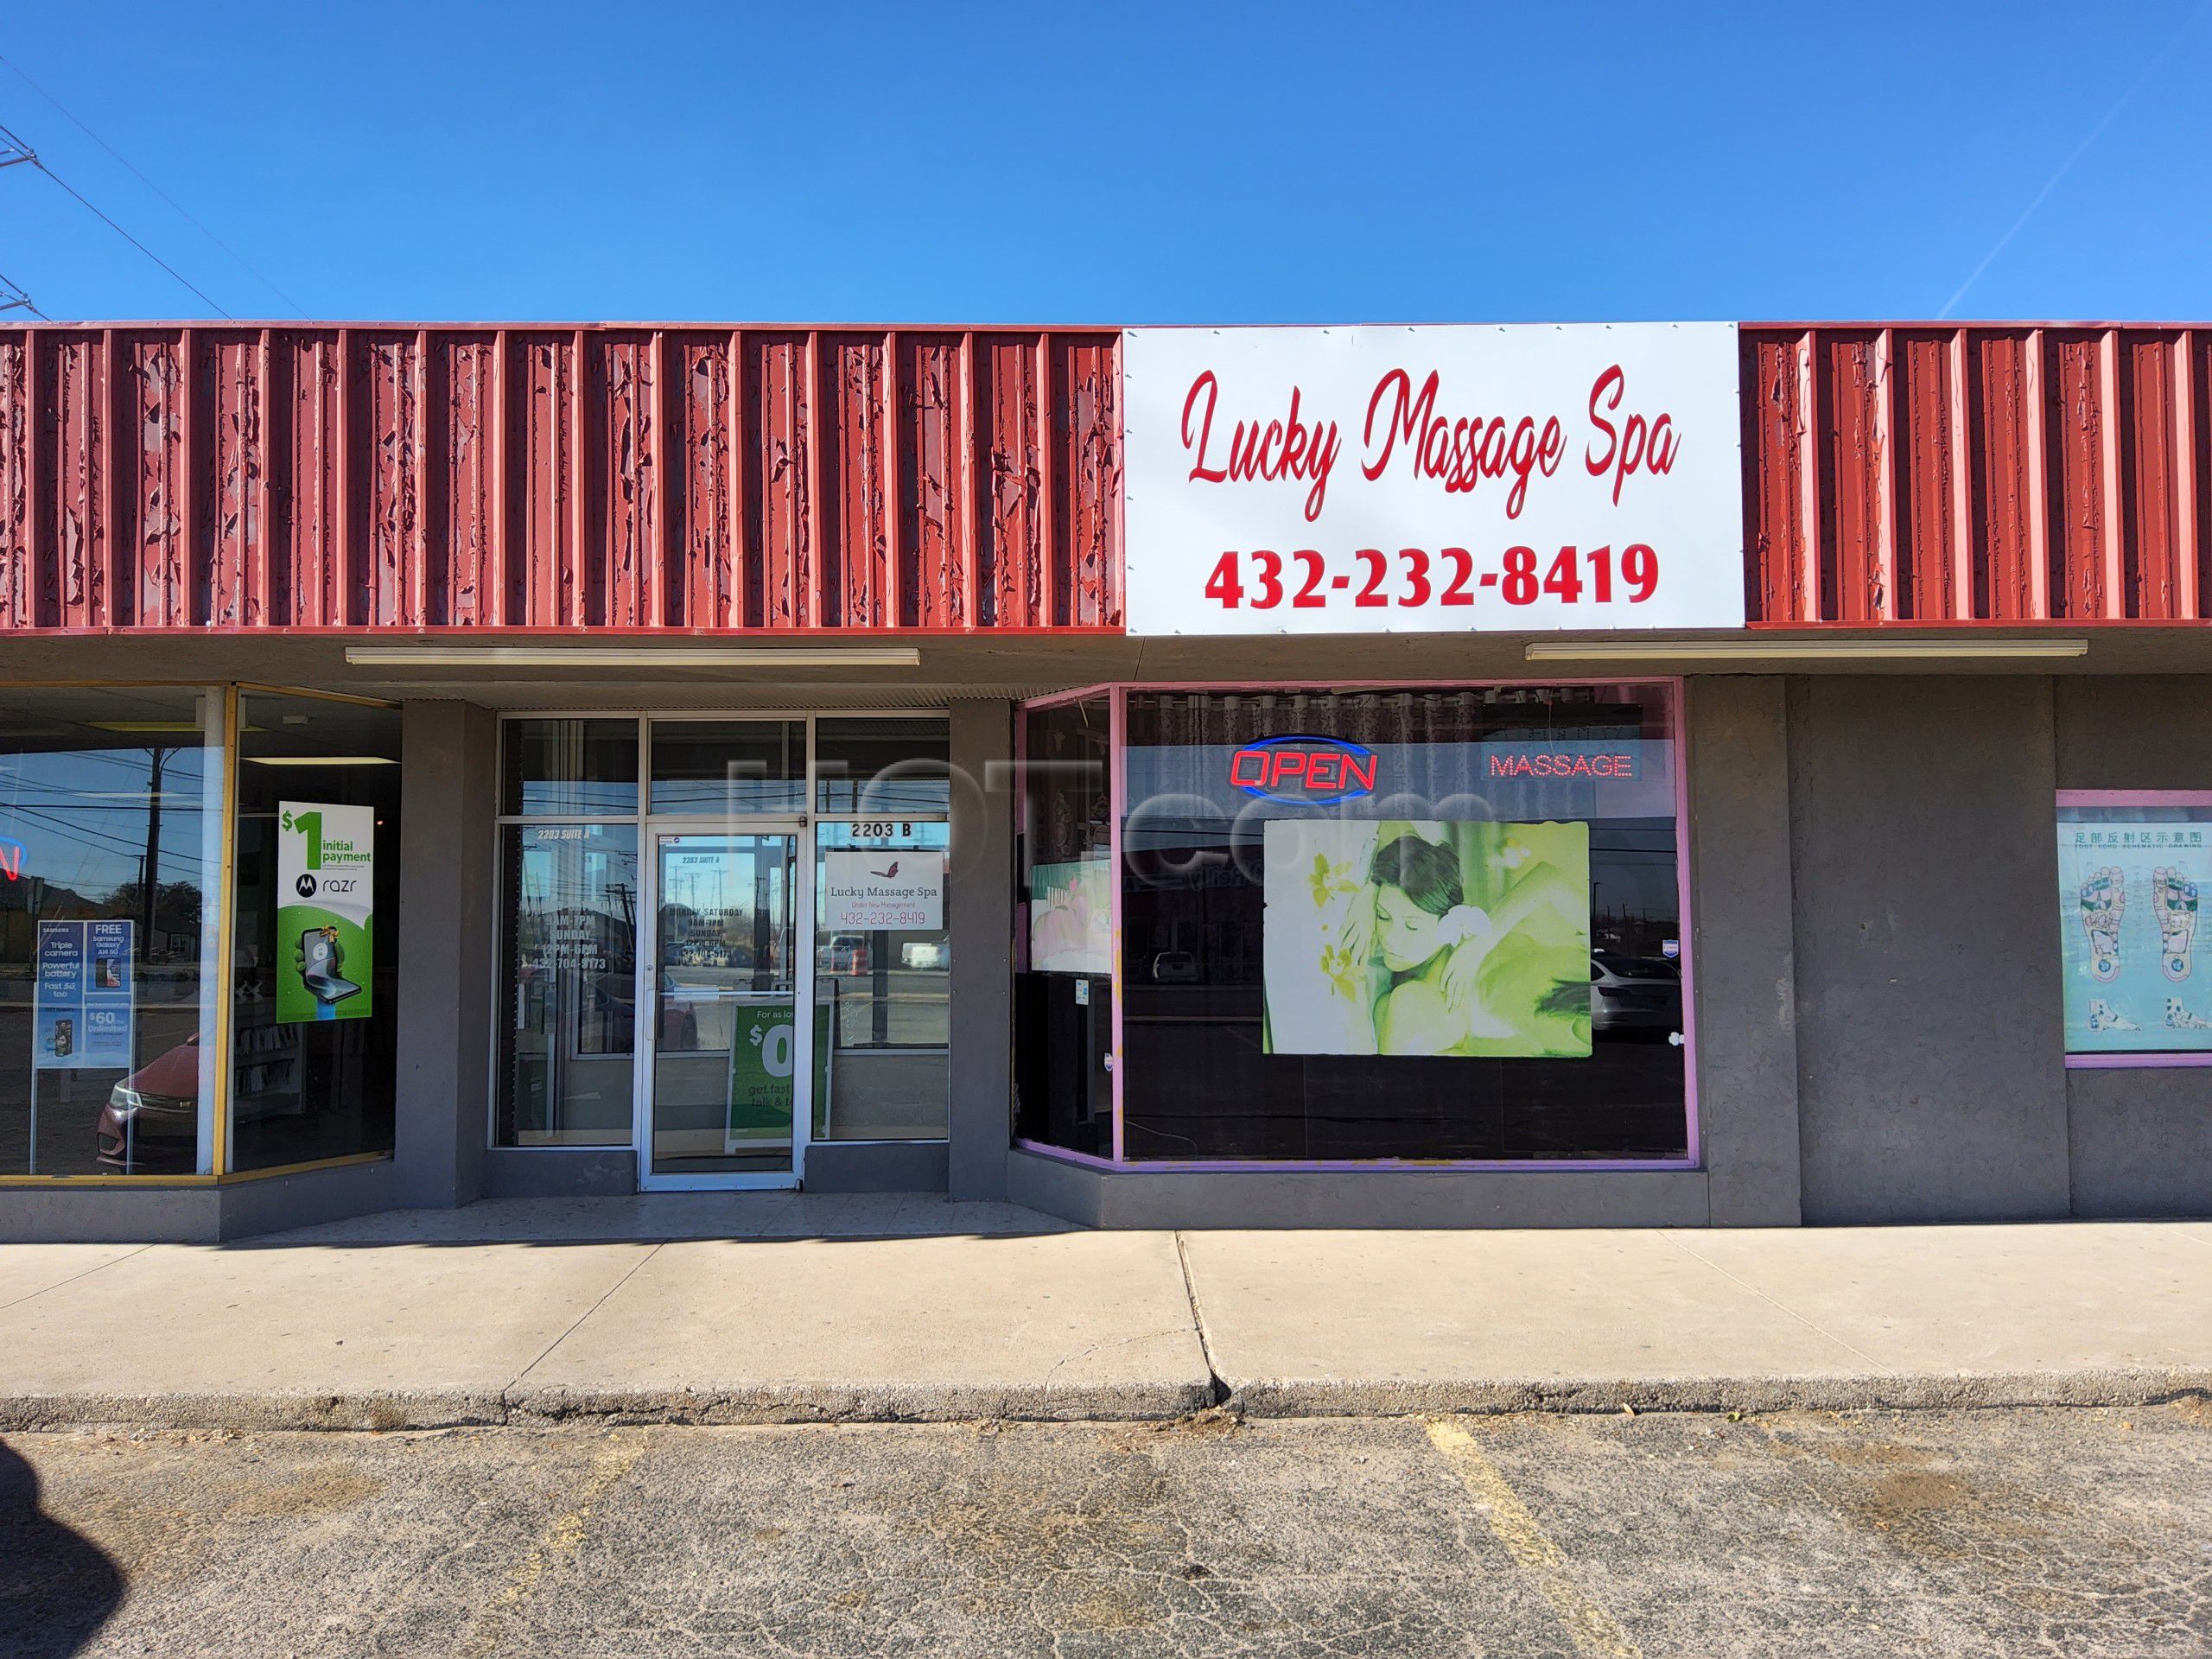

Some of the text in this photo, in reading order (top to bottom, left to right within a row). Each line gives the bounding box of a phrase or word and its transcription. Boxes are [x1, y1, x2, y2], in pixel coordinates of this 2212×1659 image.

[1180, 364, 1681, 522] Lucky Massage Spa
[1205, 543, 1659, 609] 432-232-8419
[1230, 749, 1378, 791] OPEN
[1488, 753, 1633, 778] MASSAGE
[538, 830, 560, 839] 2203
[561, 830, 582, 839] SUITE
[852, 823, 912, 837] 2203 B
[2075, 831, 2202, 843] 足部反射区示意图
[322, 840, 353, 851] initial
[322, 853, 372, 863] payment
[322, 880, 358, 893] razr
[830, 887, 938, 899] Lucky Massage Spa
[841, 912, 925, 925] 432-232-8419
[95, 924, 122, 935] FREE
[690, 929, 721, 938] SUNDAY
[45, 970, 77, 979] battery
[89, 1011, 116, 1025] $60
[757, 1010, 772, 1019] For
[783, 1010, 793, 1019] lo
[87, 1024, 128, 1033] Unlimited
[748, 1084, 790, 1096] get fast
[752, 1096, 771, 1107] talk
[774, 1096, 782, 1107] &
